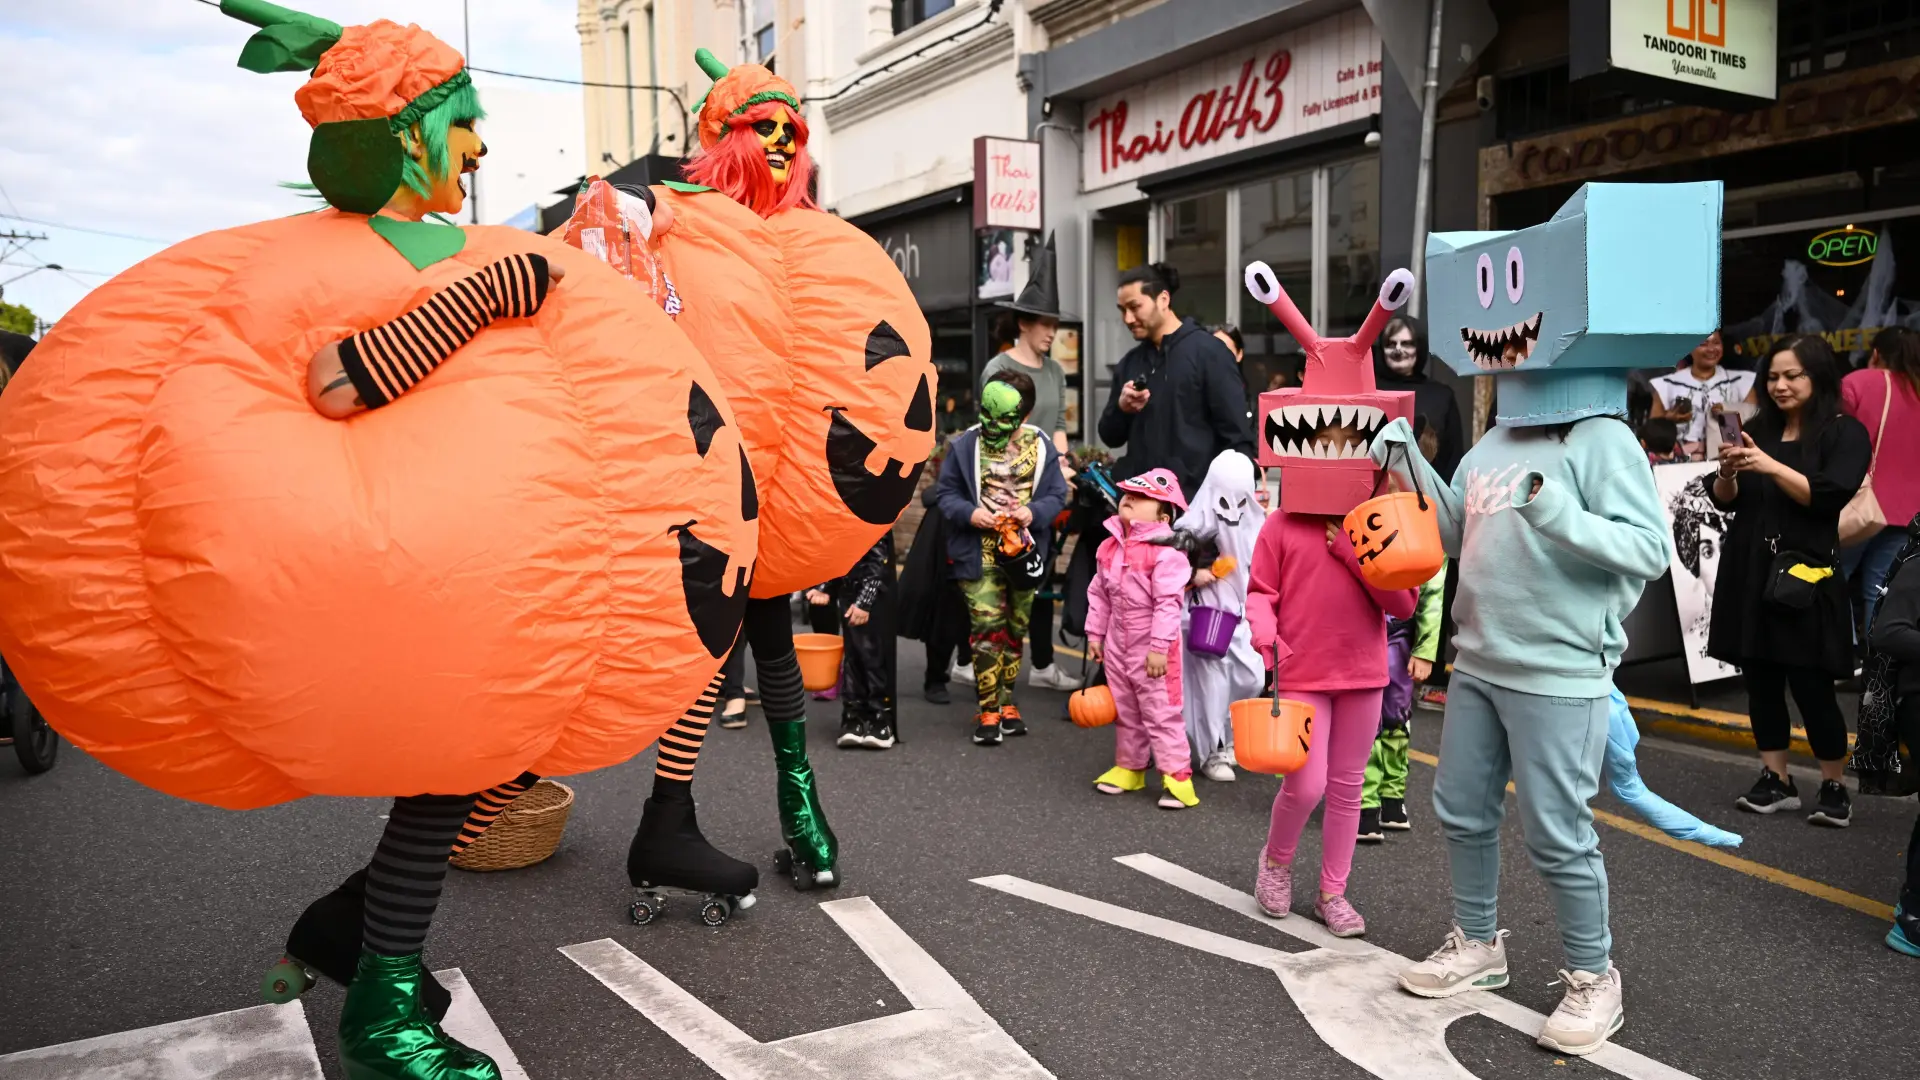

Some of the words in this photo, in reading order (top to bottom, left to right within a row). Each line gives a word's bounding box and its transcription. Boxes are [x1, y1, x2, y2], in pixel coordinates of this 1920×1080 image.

[1644, 35, 1707, 61] TANDOORI
[1710, 50, 1747, 69] TIMES
[1672, 59, 1717, 80] Yarraville
[1303, 101, 1321, 118] Fully
[1362, 88, 1368, 100] &
[1088, 100, 1174, 174] Thai
[990, 154, 1032, 178] Thai
[1808, 235, 1878, 260] OPEN
[1551, 696, 1586, 707] BONDS
